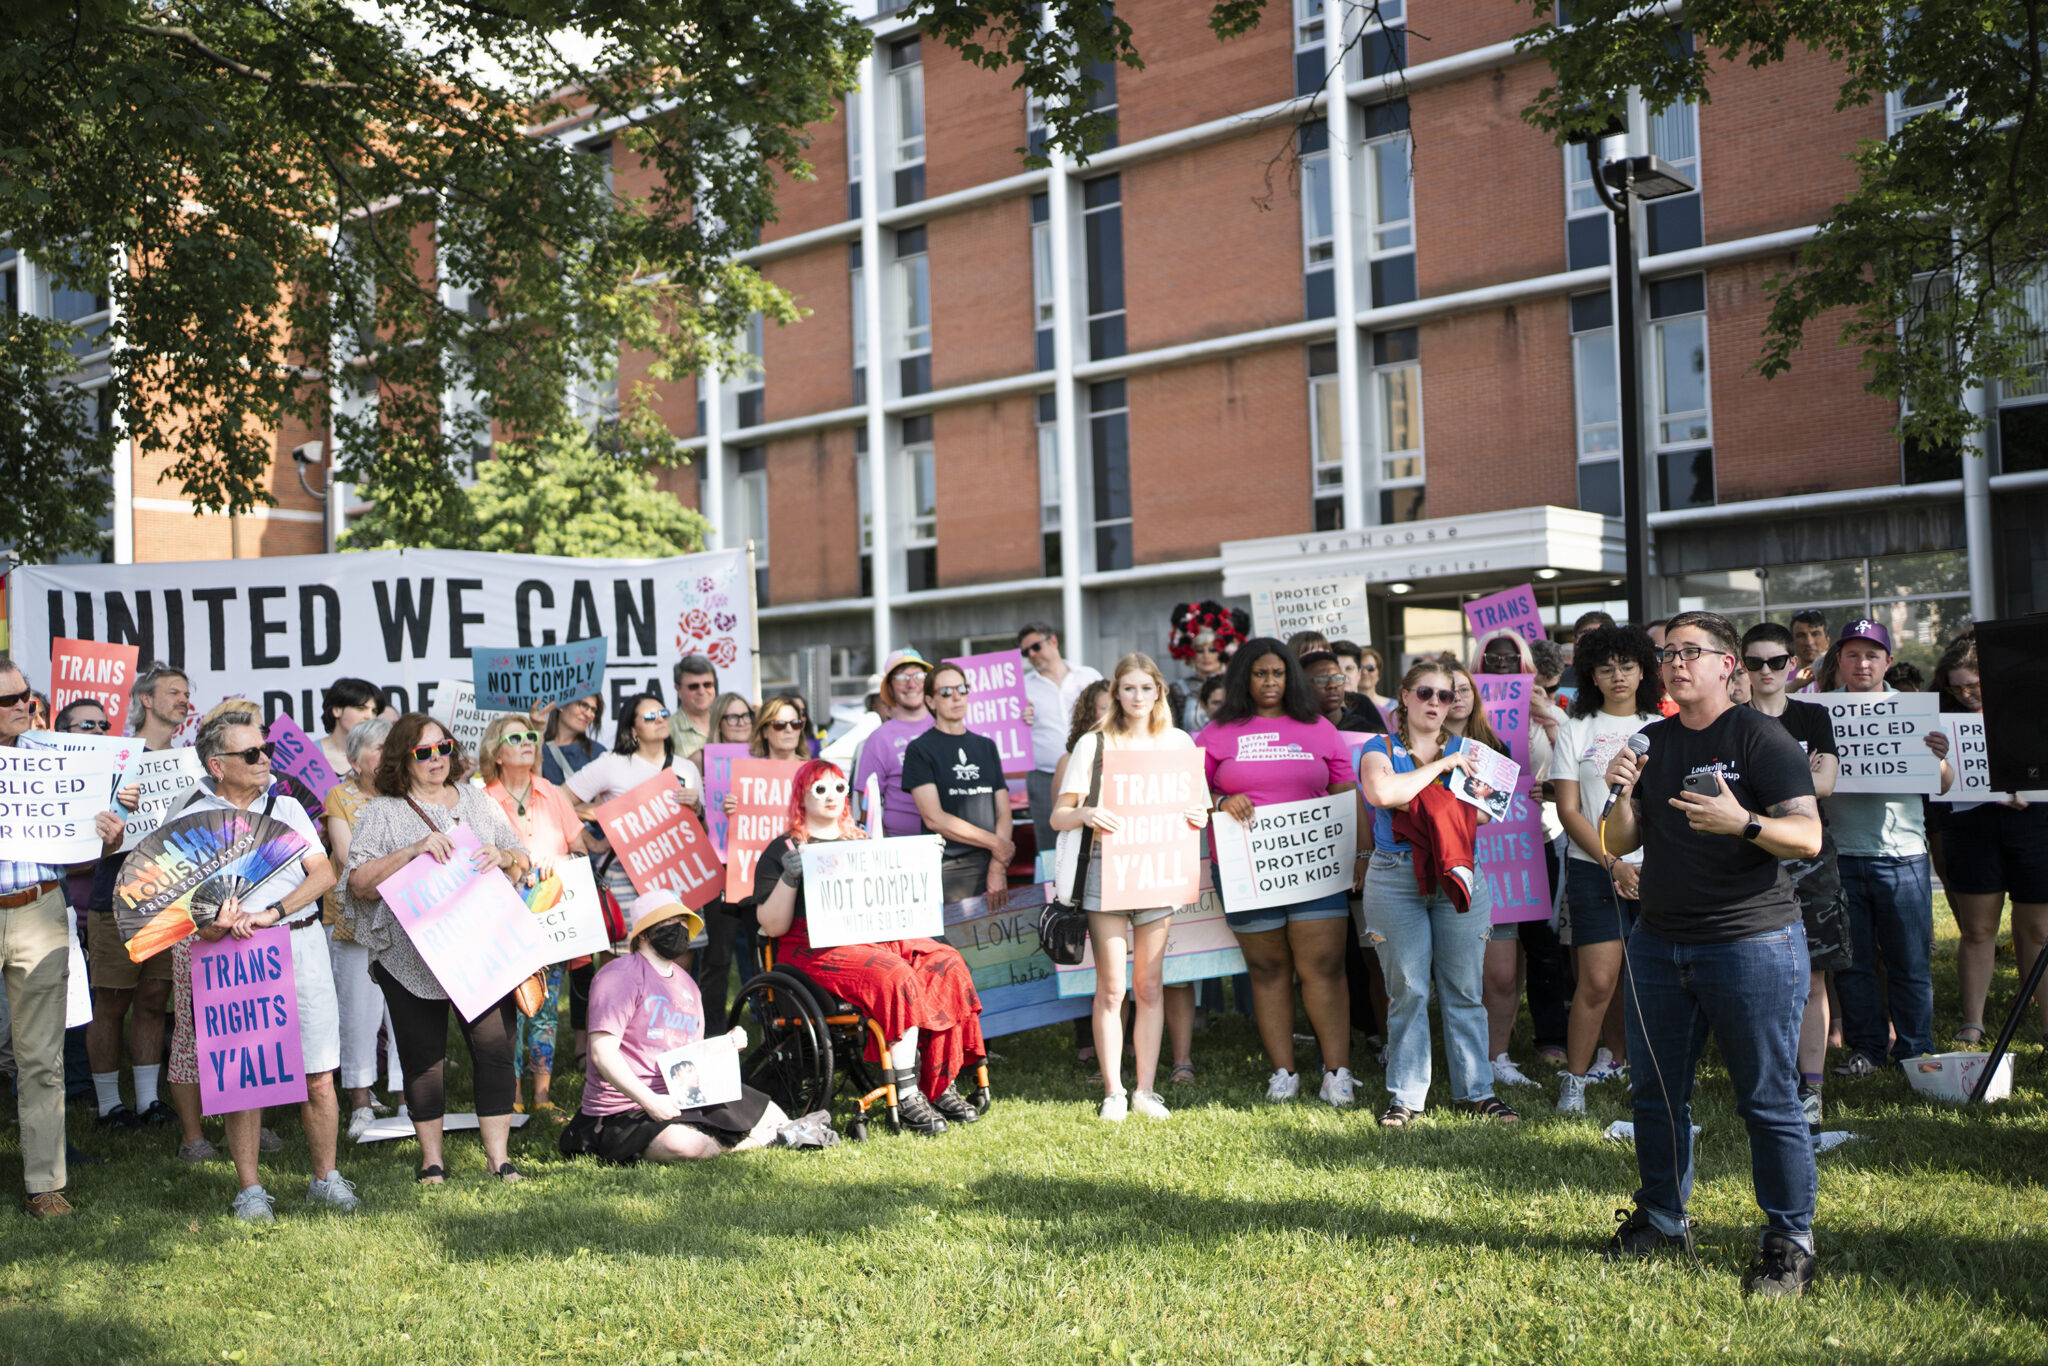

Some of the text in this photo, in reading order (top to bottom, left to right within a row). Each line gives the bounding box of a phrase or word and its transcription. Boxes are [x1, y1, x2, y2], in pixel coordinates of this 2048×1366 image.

[1275, 584, 1338, 600] PROTECT
[1277, 597, 1351, 615] PUBLIC ED
[48, 577, 658, 673] UNITED WE CAN
[1280, 612, 1343, 628] PROTECT
[1474, 596, 1530, 629] TRANS
[60, 655, 126, 685] TRANS
[516, 652, 570, 670] WE WILL
[488, 661, 595, 694] NOT COMPLY
[964, 662, 1017, 693] RANS
[1481, 681, 1522, 701] ANS
[963, 696, 1021, 724] IGHTS
[1826, 702, 1899, 718] OTECT
[453, 724, 485, 737] PROT
[1834, 721, 1915, 738] BLIC ED
[0, 757, 67, 772] OTECT
[270, 731, 304, 772] ANS
[1836, 742, 1902, 758] OTECT
[136, 758, 180, 776] OTECT
[1691, 762, 1728, 774] Louisville
[1861, 761, 1908, 775] KIDS
[0, 779, 86, 795] BLIC ED
[138, 778, 171, 795] BLIC
[176, 775, 195, 789] ED
[740, 777, 793, 807] TRAN
[1112, 771, 1191, 806] TRANS
[0, 802, 70, 817] OTECT
[610, 789, 682, 844] TRANS
[1249, 806, 1332, 833] PROTECT
[23, 823, 76, 839] KIDS
[126, 818, 159, 834] OUR
[737, 814, 788, 841] RIGH
[1112, 813, 1189, 846] RIGHTS
[1252, 823, 1344, 854] PUBLIC ED
[628, 820, 696, 876] RIGHTS
[847, 847, 902, 872] WE WILL
[1256, 844, 1336, 873] PROTECT
[1478, 832, 1533, 864] GHTS
[138, 834, 256, 916] PRIDE FOUNDATION
[397, 846, 480, 918] TRANS
[1112, 851, 1189, 892] Y'ALL
[1259, 862, 1341, 892] OUR KIDS
[820, 872, 928, 912] NOT COMPLY
[1489, 870, 1541, 910] ALL
[973, 914, 1027, 951] LOVE
[201, 945, 282, 990] TRANS
[1010, 963, 1050, 987] hate
[204, 995, 287, 1037] RIGHTS
[644, 994, 698, 1034] Trans
[209, 1042, 295, 1092] Y'ALL
[1961, 1060, 1975, 1074] Join
